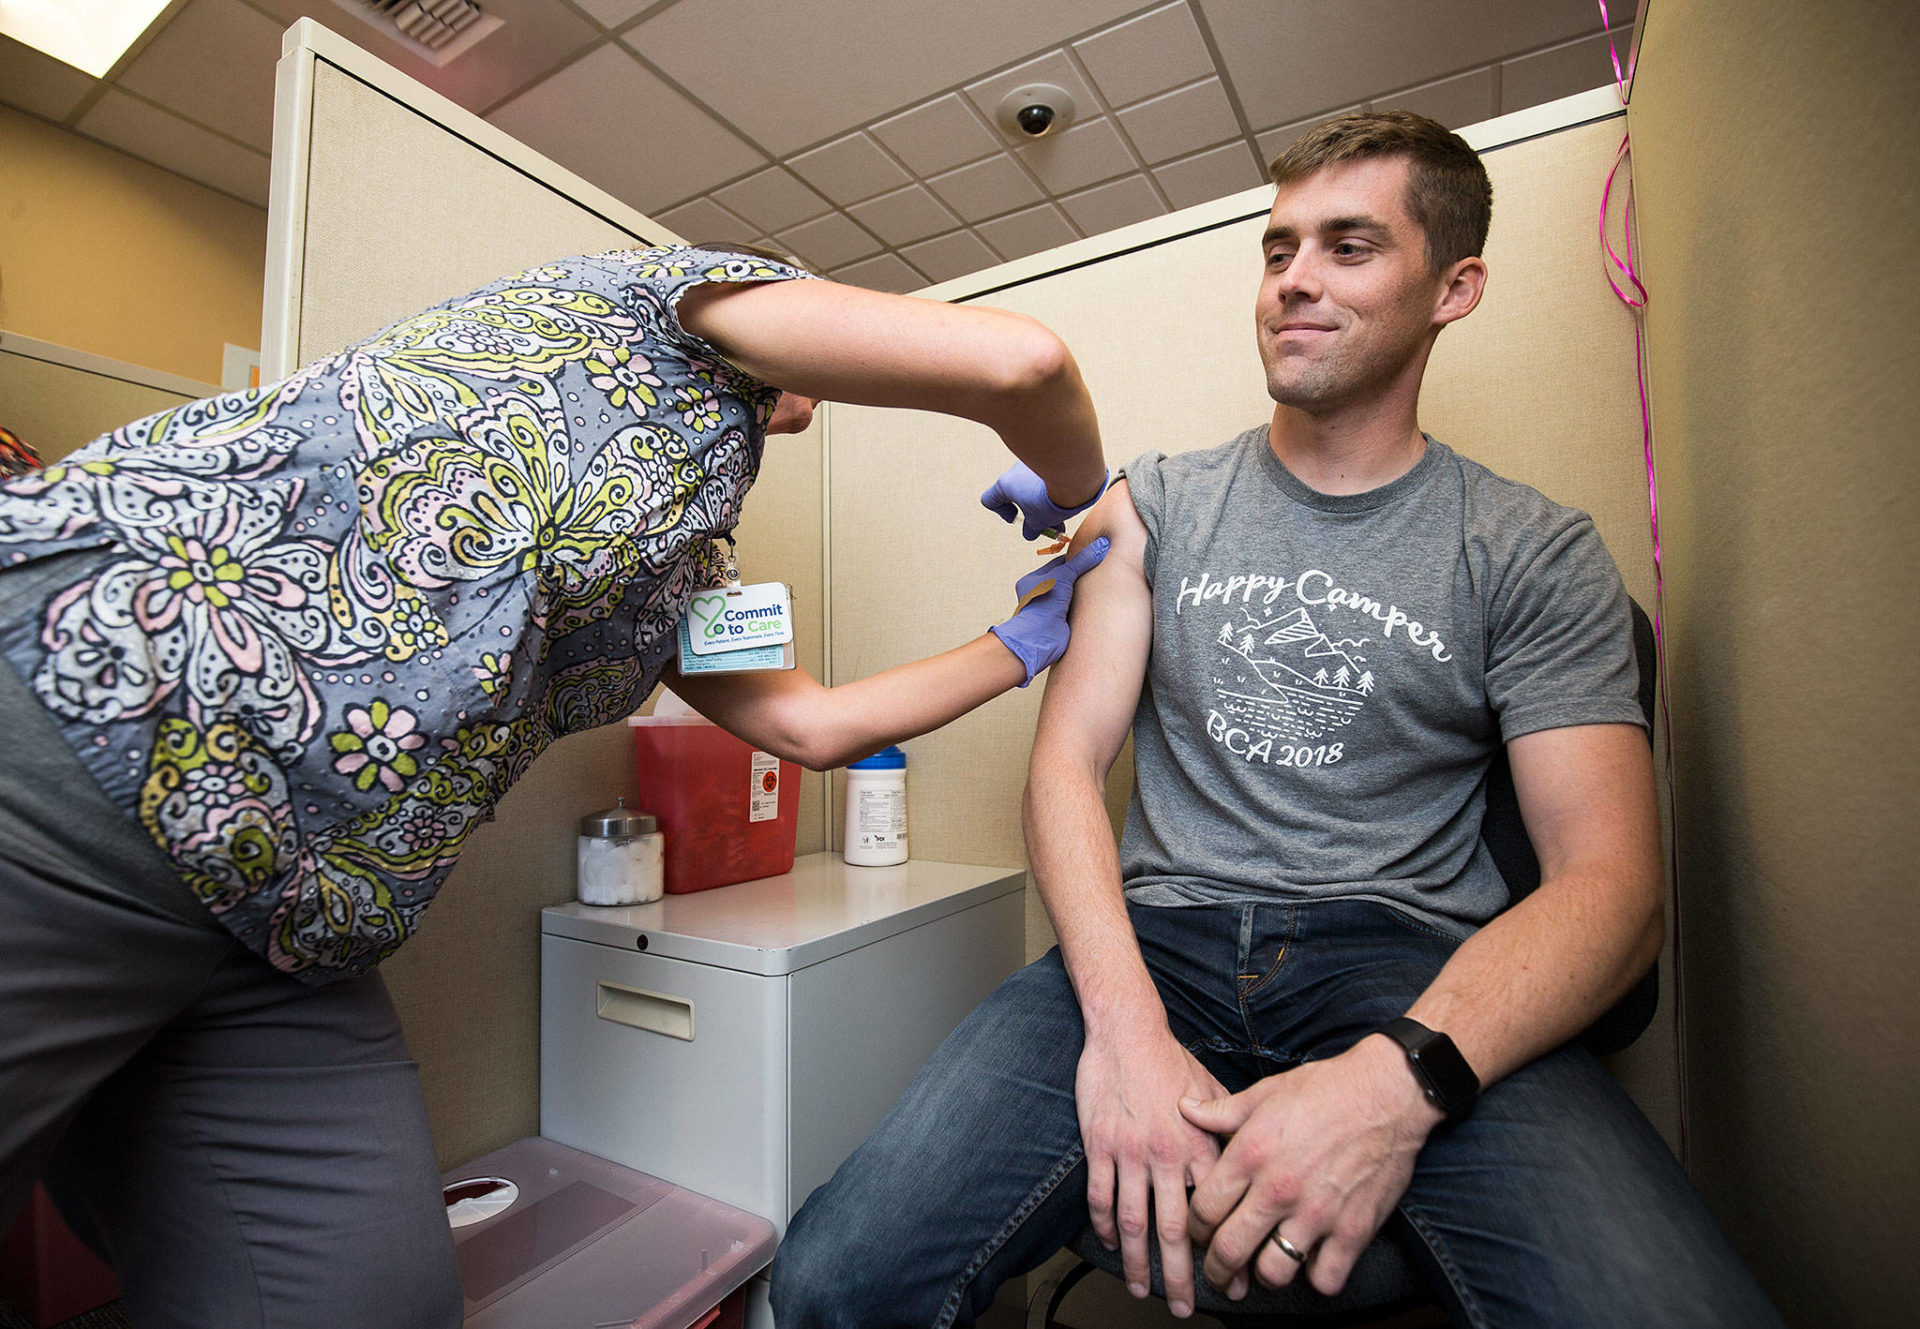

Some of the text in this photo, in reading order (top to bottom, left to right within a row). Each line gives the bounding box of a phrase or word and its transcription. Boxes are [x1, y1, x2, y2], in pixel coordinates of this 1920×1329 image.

[725, 604, 783, 621] Commit
[728, 620, 782, 635] to Care
[1177, 569, 1452, 662] Happy Camper
[1206, 709, 1344, 768] BCA 2018
